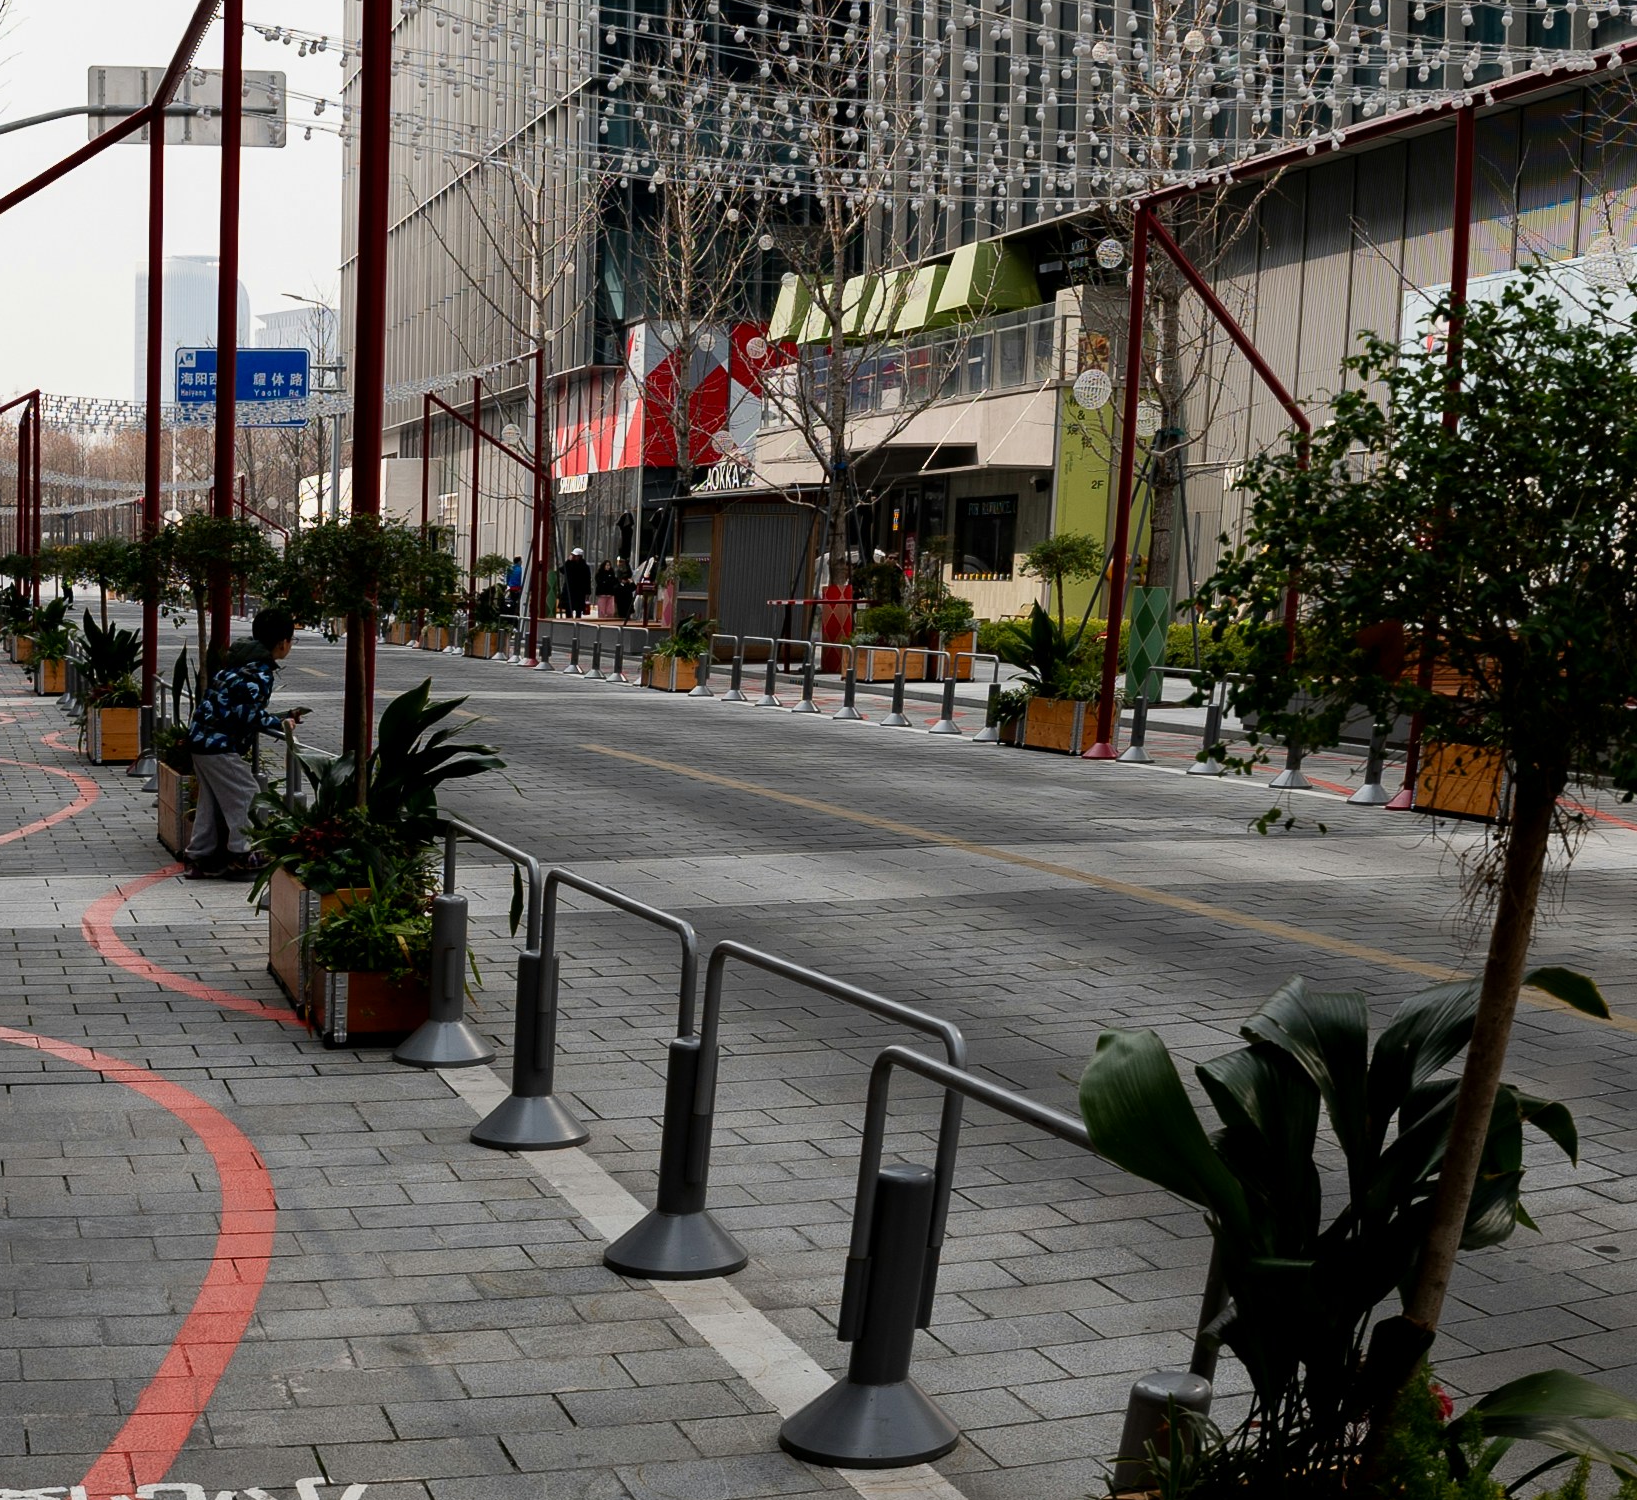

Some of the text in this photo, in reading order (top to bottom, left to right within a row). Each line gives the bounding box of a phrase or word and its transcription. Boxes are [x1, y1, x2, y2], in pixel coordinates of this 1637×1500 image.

[254, 389, 281, 397] Yaoti
[706, 464, 740, 491] AOKKA
[1091, 480, 1104, 490] 2F
